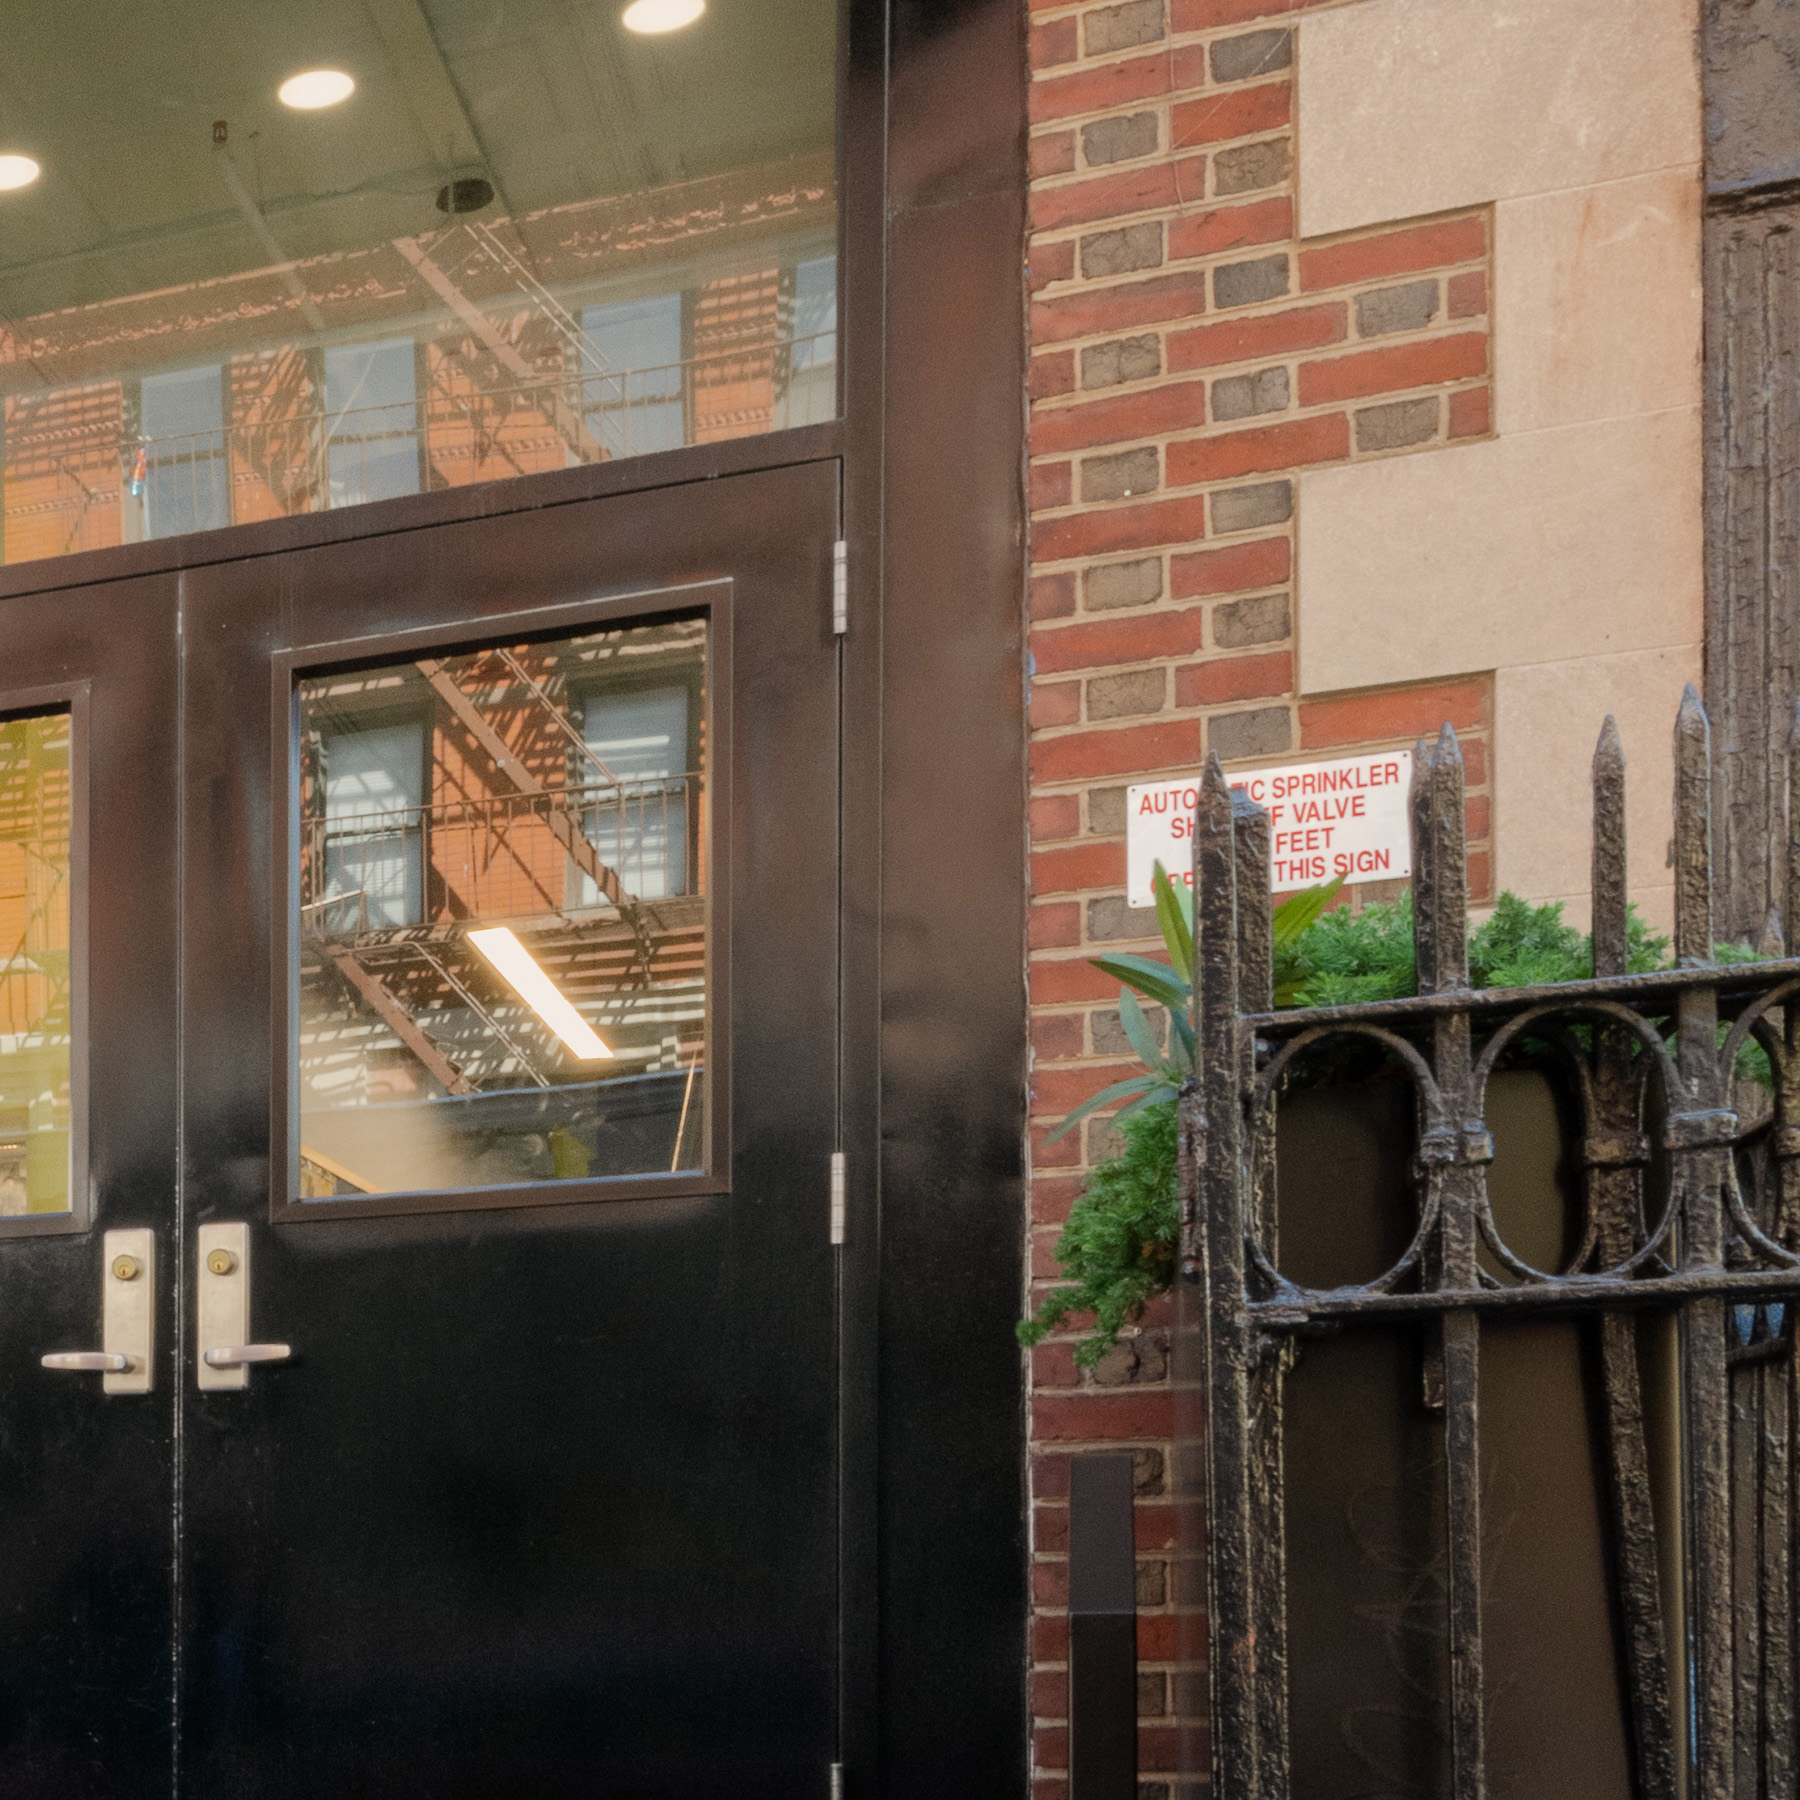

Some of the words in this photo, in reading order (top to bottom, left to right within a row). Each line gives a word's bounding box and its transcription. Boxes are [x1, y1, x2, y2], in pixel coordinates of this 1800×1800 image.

[1272, 762, 1399, 799] SPRINKLER
[1293, 795, 1366, 824] VALVE
[1275, 827, 1335, 854] FEET
[1274, 856, 1325, 882] THIS
[1334, 849, 1390, 874] SIGN
